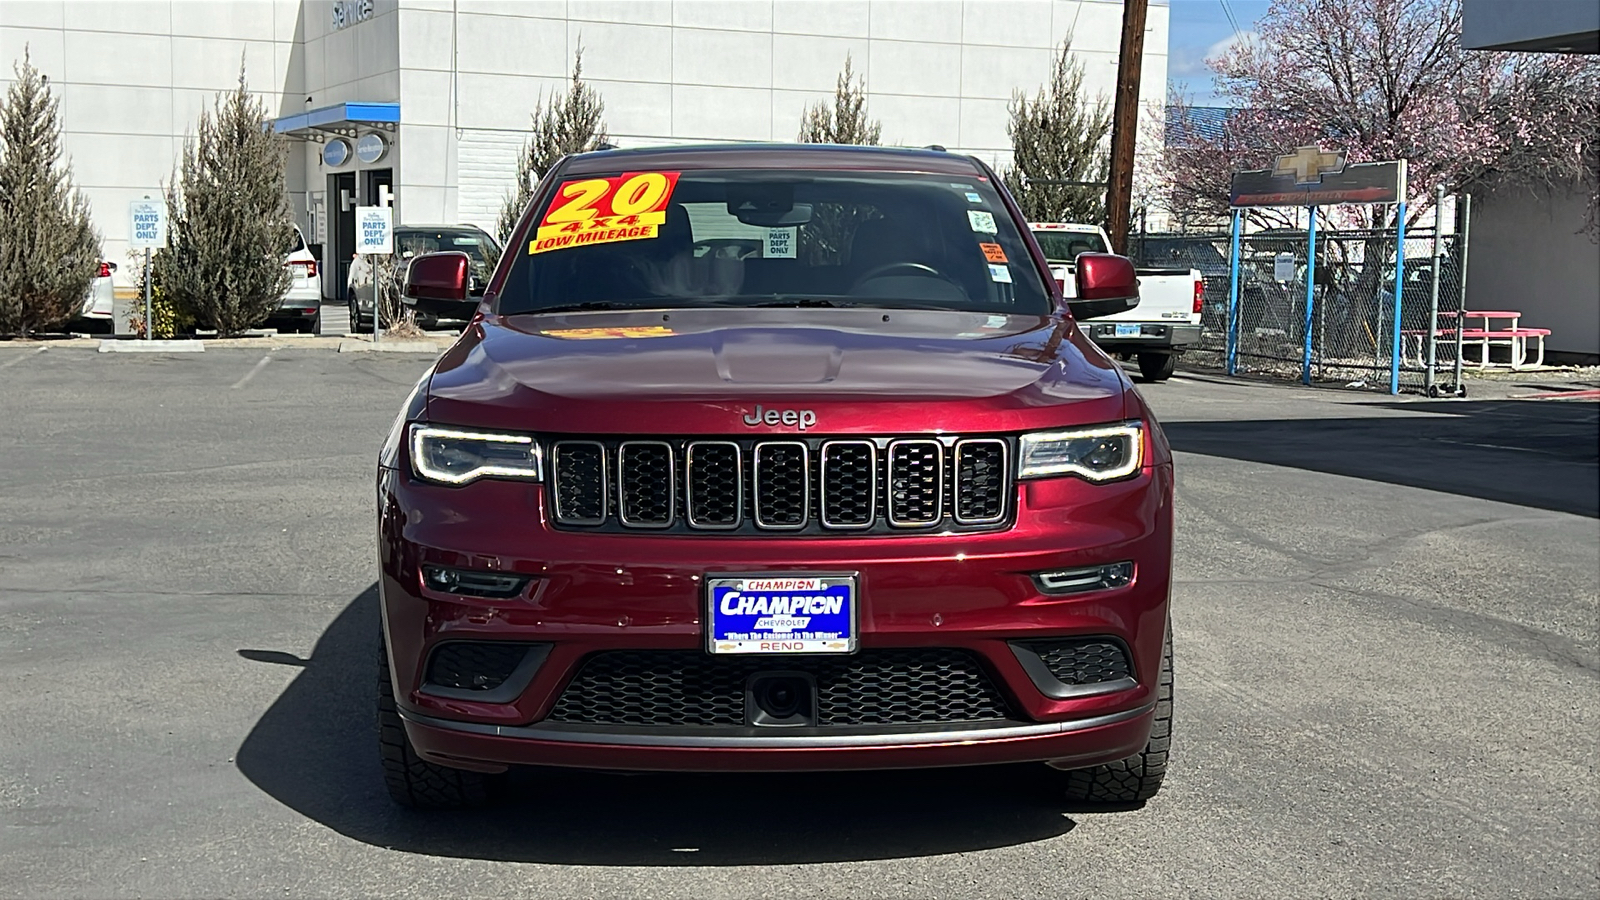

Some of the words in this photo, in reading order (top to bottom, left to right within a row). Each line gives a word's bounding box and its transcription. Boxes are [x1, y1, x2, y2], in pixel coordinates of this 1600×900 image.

[333, 0, 374, 30] Service
[547, 173, 670, 224] 20
[134, 214, 159, 222] PARTS
[136, 231, 158, 239] ONLY
[535, 234, 574, 252] LOW
[575, 226, 652, 248] MILEAGE
[743, 404, 816, 431] Jeep
[748, 580, 815, 591] CHAMPION
[758, 619, 806, 627] CHEVROLET
[750, 632, 762, 640] The
[763, 632, 794, 640] Customer
[760, 642, 804, 651] RENO
